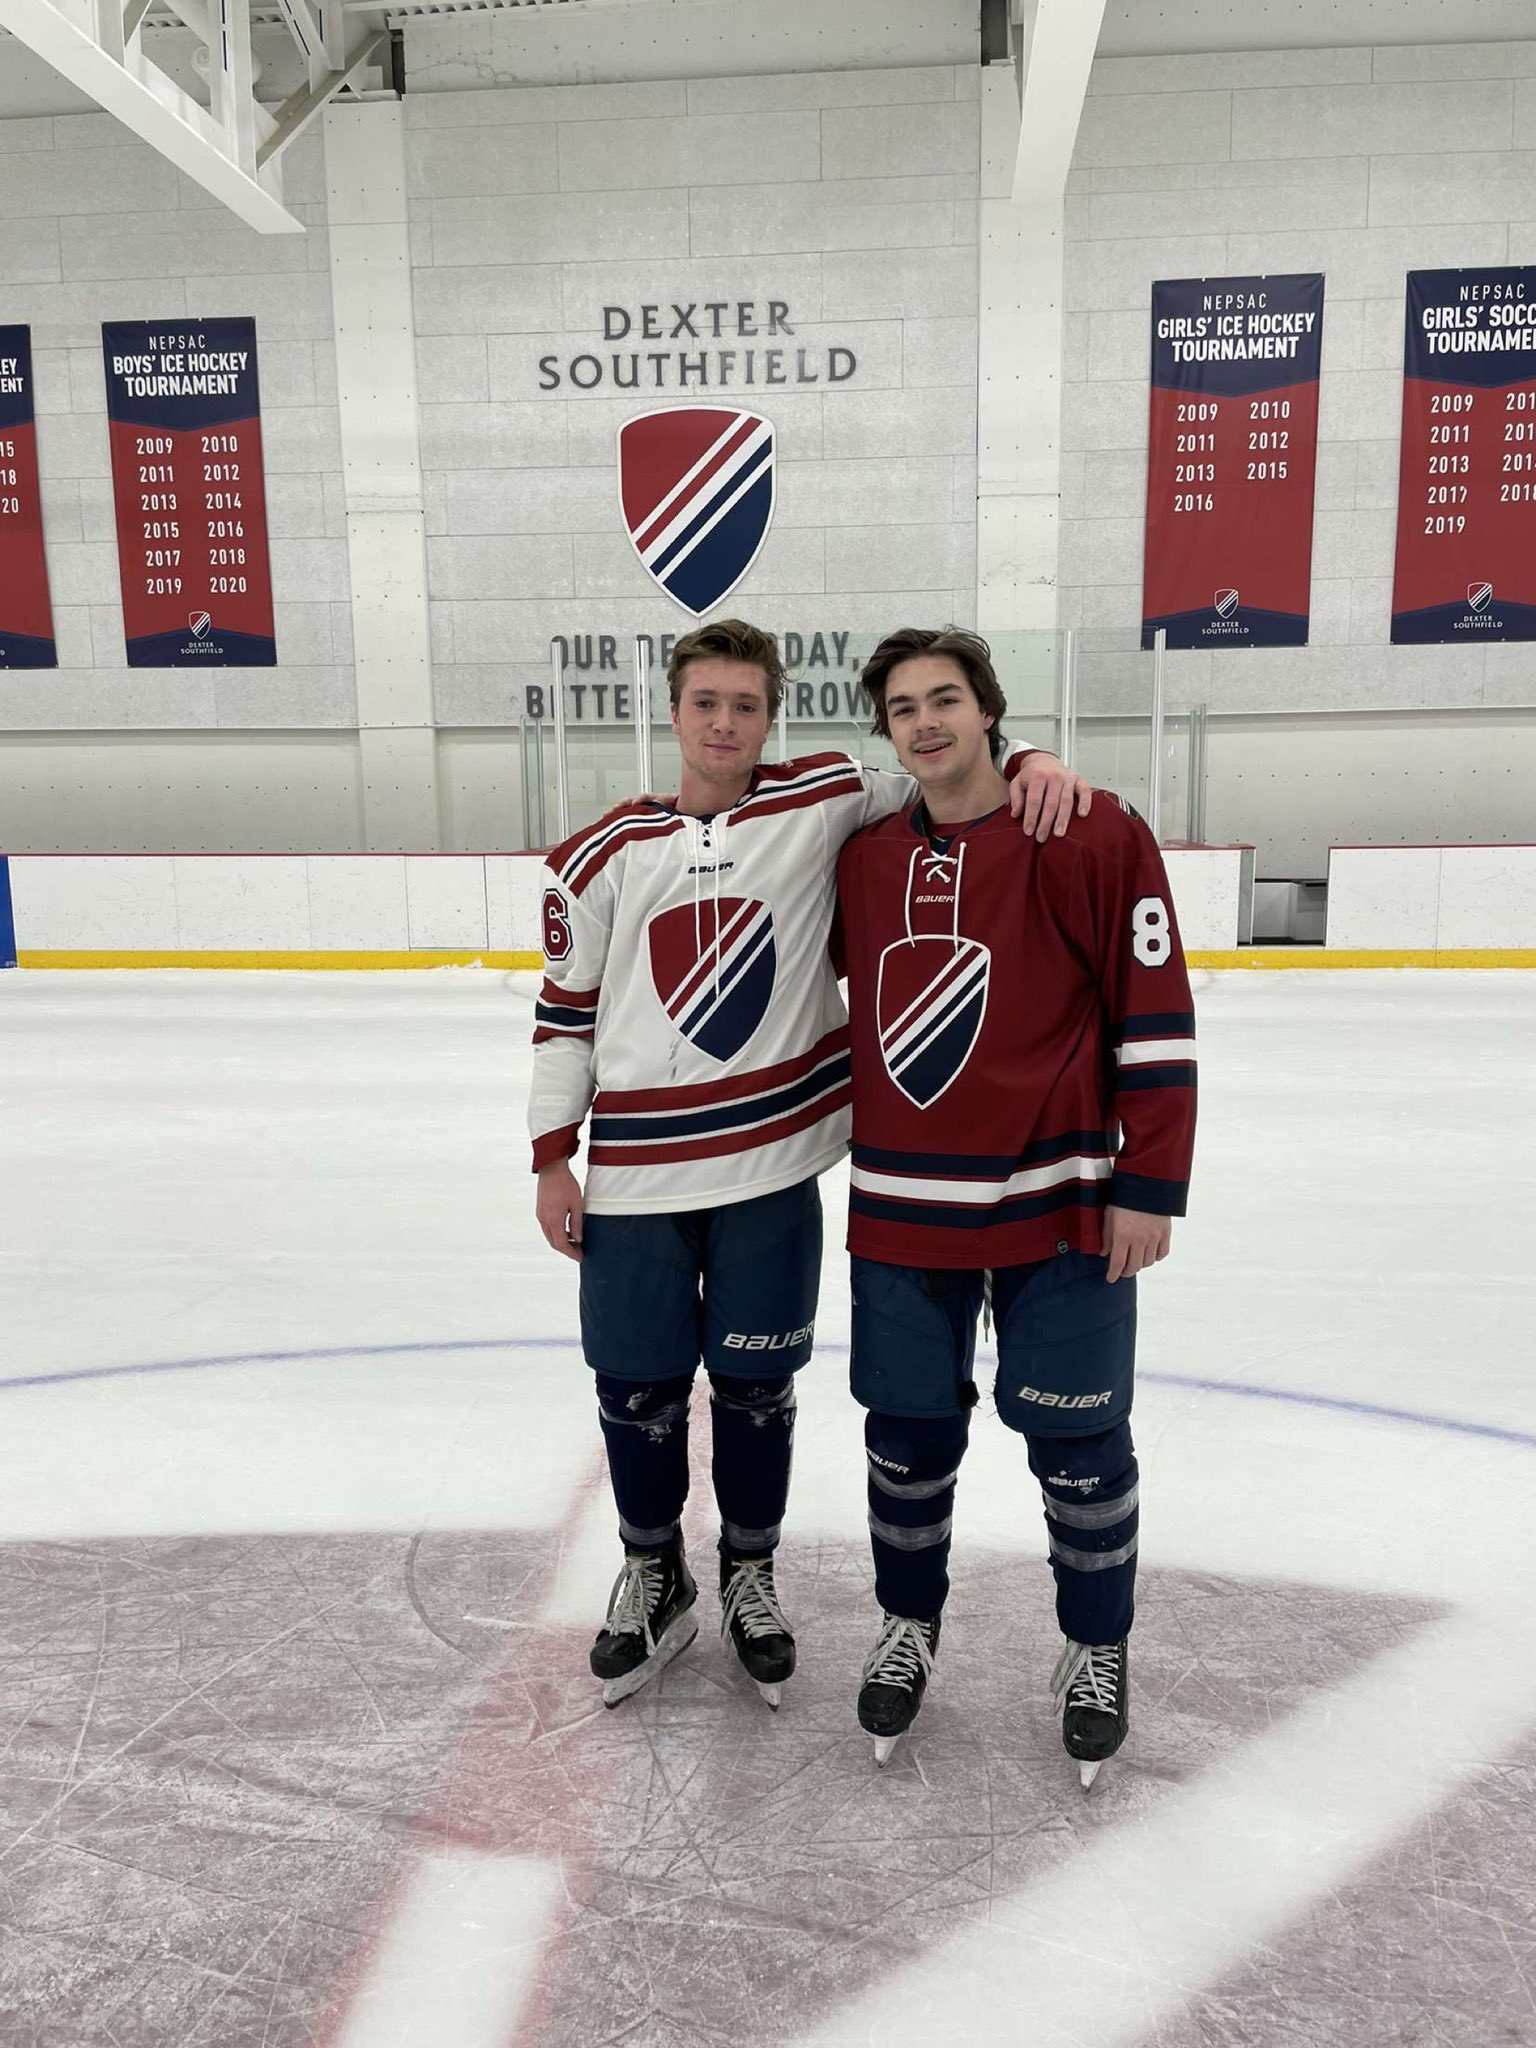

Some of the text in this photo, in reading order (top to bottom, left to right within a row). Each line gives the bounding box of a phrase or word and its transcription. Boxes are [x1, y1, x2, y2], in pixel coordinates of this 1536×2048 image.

[1203, 293, 1267, 311] NEPSAC
[1459, 283, 1525, 301] NEPSAC
[603, 301, 795, 341] DEXTER
[1157, 312, 1315, 339] GIRLS' ICE HOCKEY
[1422, 306, 1484, 329] GIRLS'
[149, 334, 206, 350] NEPSAC
[1171, 336, 1299, 362] TOURNAMENT
[1427, 328, 1536, 354] TOURNAME
[0, 358, 17, 375] EY
[113, 352, 248, 375] BOYS' ICE HOCKEY
[538, 348, 856, 390] SOUTHFIELD
[0, 378, 24, 393] ENT
[125, 374, 238, 397] TOURNAMENT
[1177, 401, 1290, 422] 2009 2010
[1430, 392, 1536, 413] 2009 201
[1176, 431, 1289, 453] 2011 2012
[1430, 422, 1534, 444] 2011 201
[0, 441, 14, 457] 15
[136, 435, 238, 455] 2009 2010
[139, 464, 240, 483] 2011 2012
[1175, 462, 1288, 482] 2013 2015
[1428, 453, 1536, 474] 2013 201
[0, 469, 17, 486] 18
[141, 493, 242, 511] 2013 2014
[1174, 493, 1214, 512] 2016
[1427, 485, 1467, 504] 2017
[1, 497, 19, 514] 20
[144, 521, 244, 539] 2015 2016
[1424, 516, 1466, 534] 2019
[145, 549, 245, 567] 2017 2018
[146, 576, 247, 594] 2019 2020
[1453, 621, 1503, 629] SOUTHFIELD
[785, 631, 859, 672] DAY,
[526, 681, 873, 719] BTTE ROW
[541, 887, 573, 961] 6
[1132, 896, 1171, 968] 8
